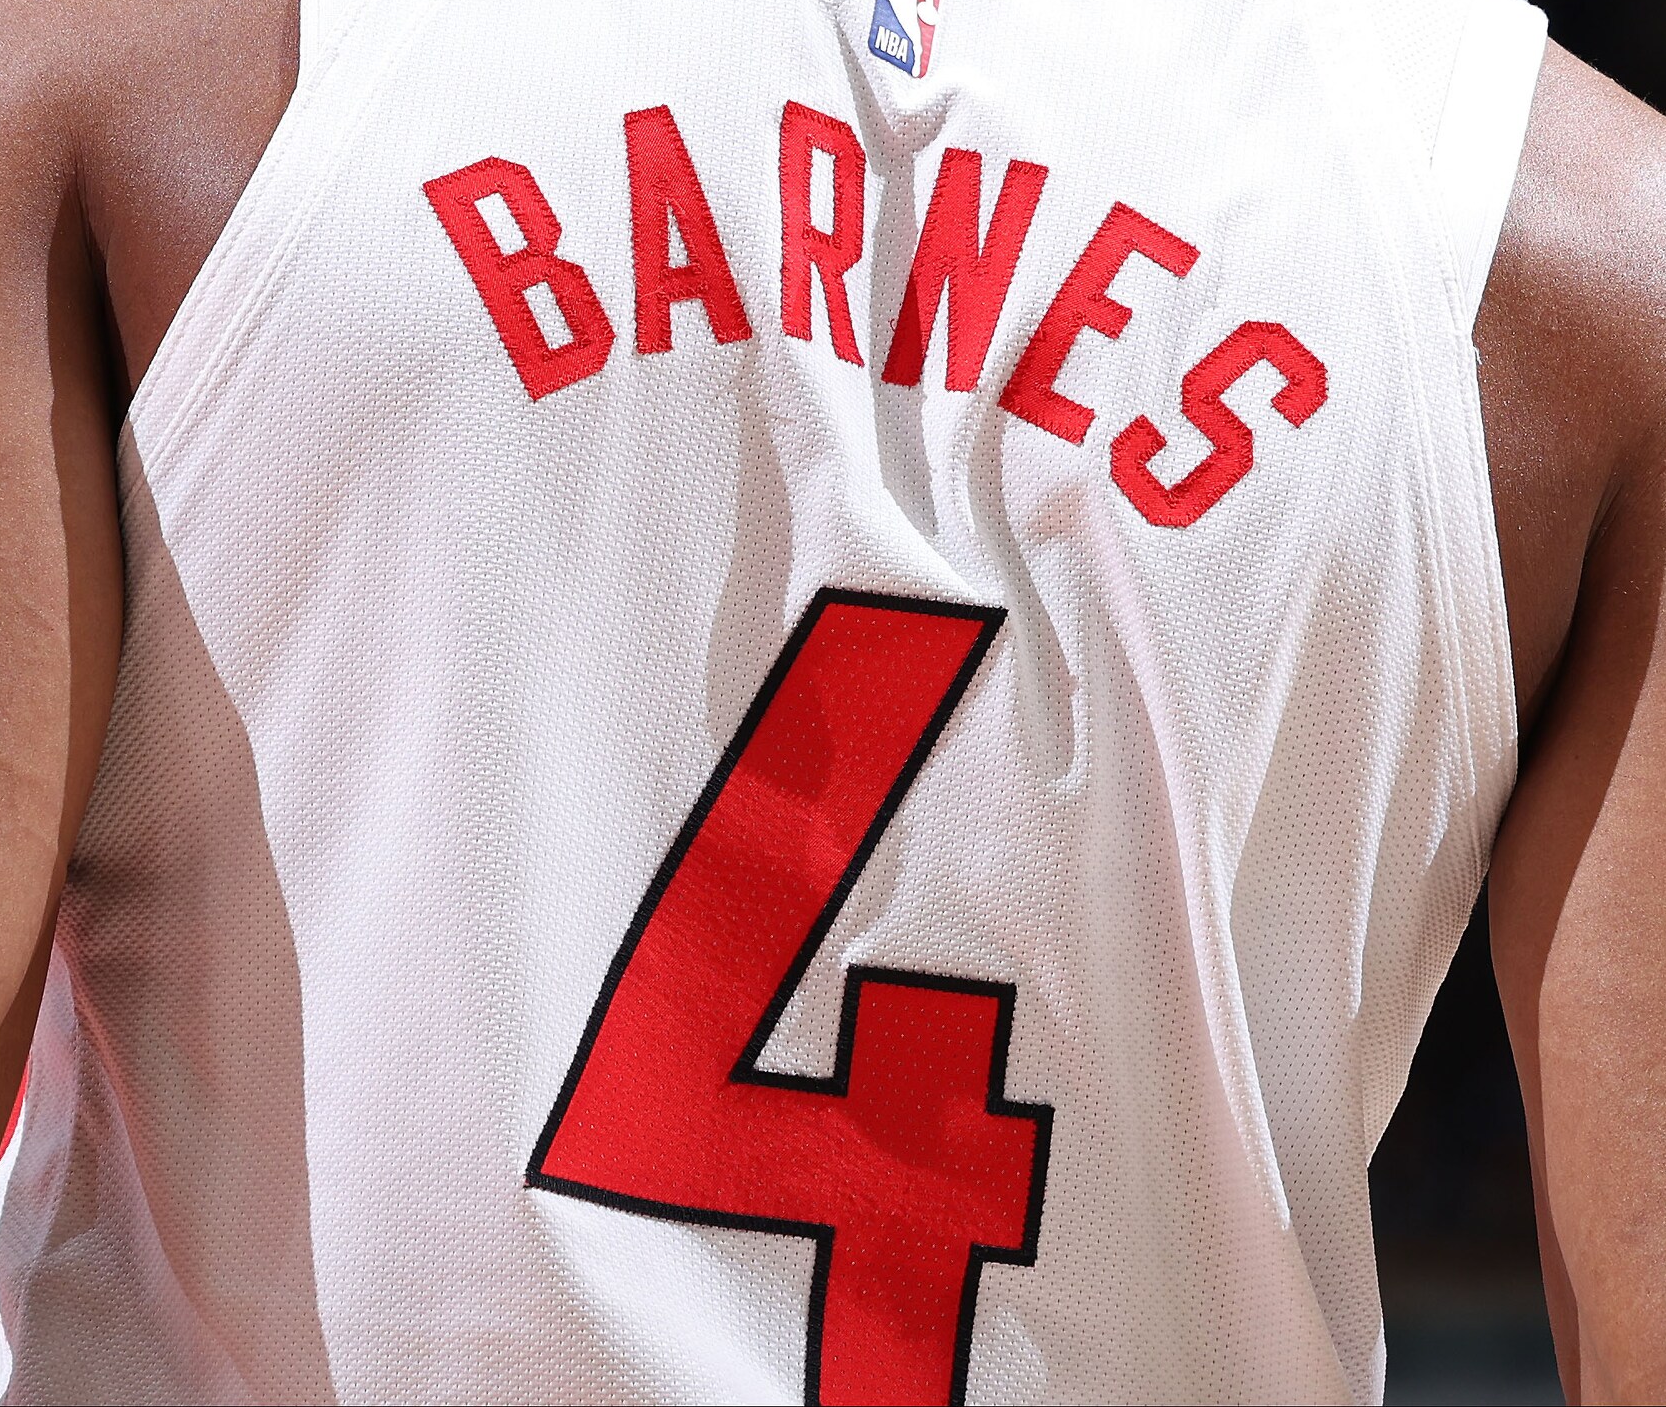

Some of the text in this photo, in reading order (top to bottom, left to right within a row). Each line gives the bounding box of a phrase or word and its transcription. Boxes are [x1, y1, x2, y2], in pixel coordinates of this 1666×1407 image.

[874, 26, 908, 63] NBA
[423, 99, 1329, 528] BARNES
[525, 587, 1054, 1407] 4
